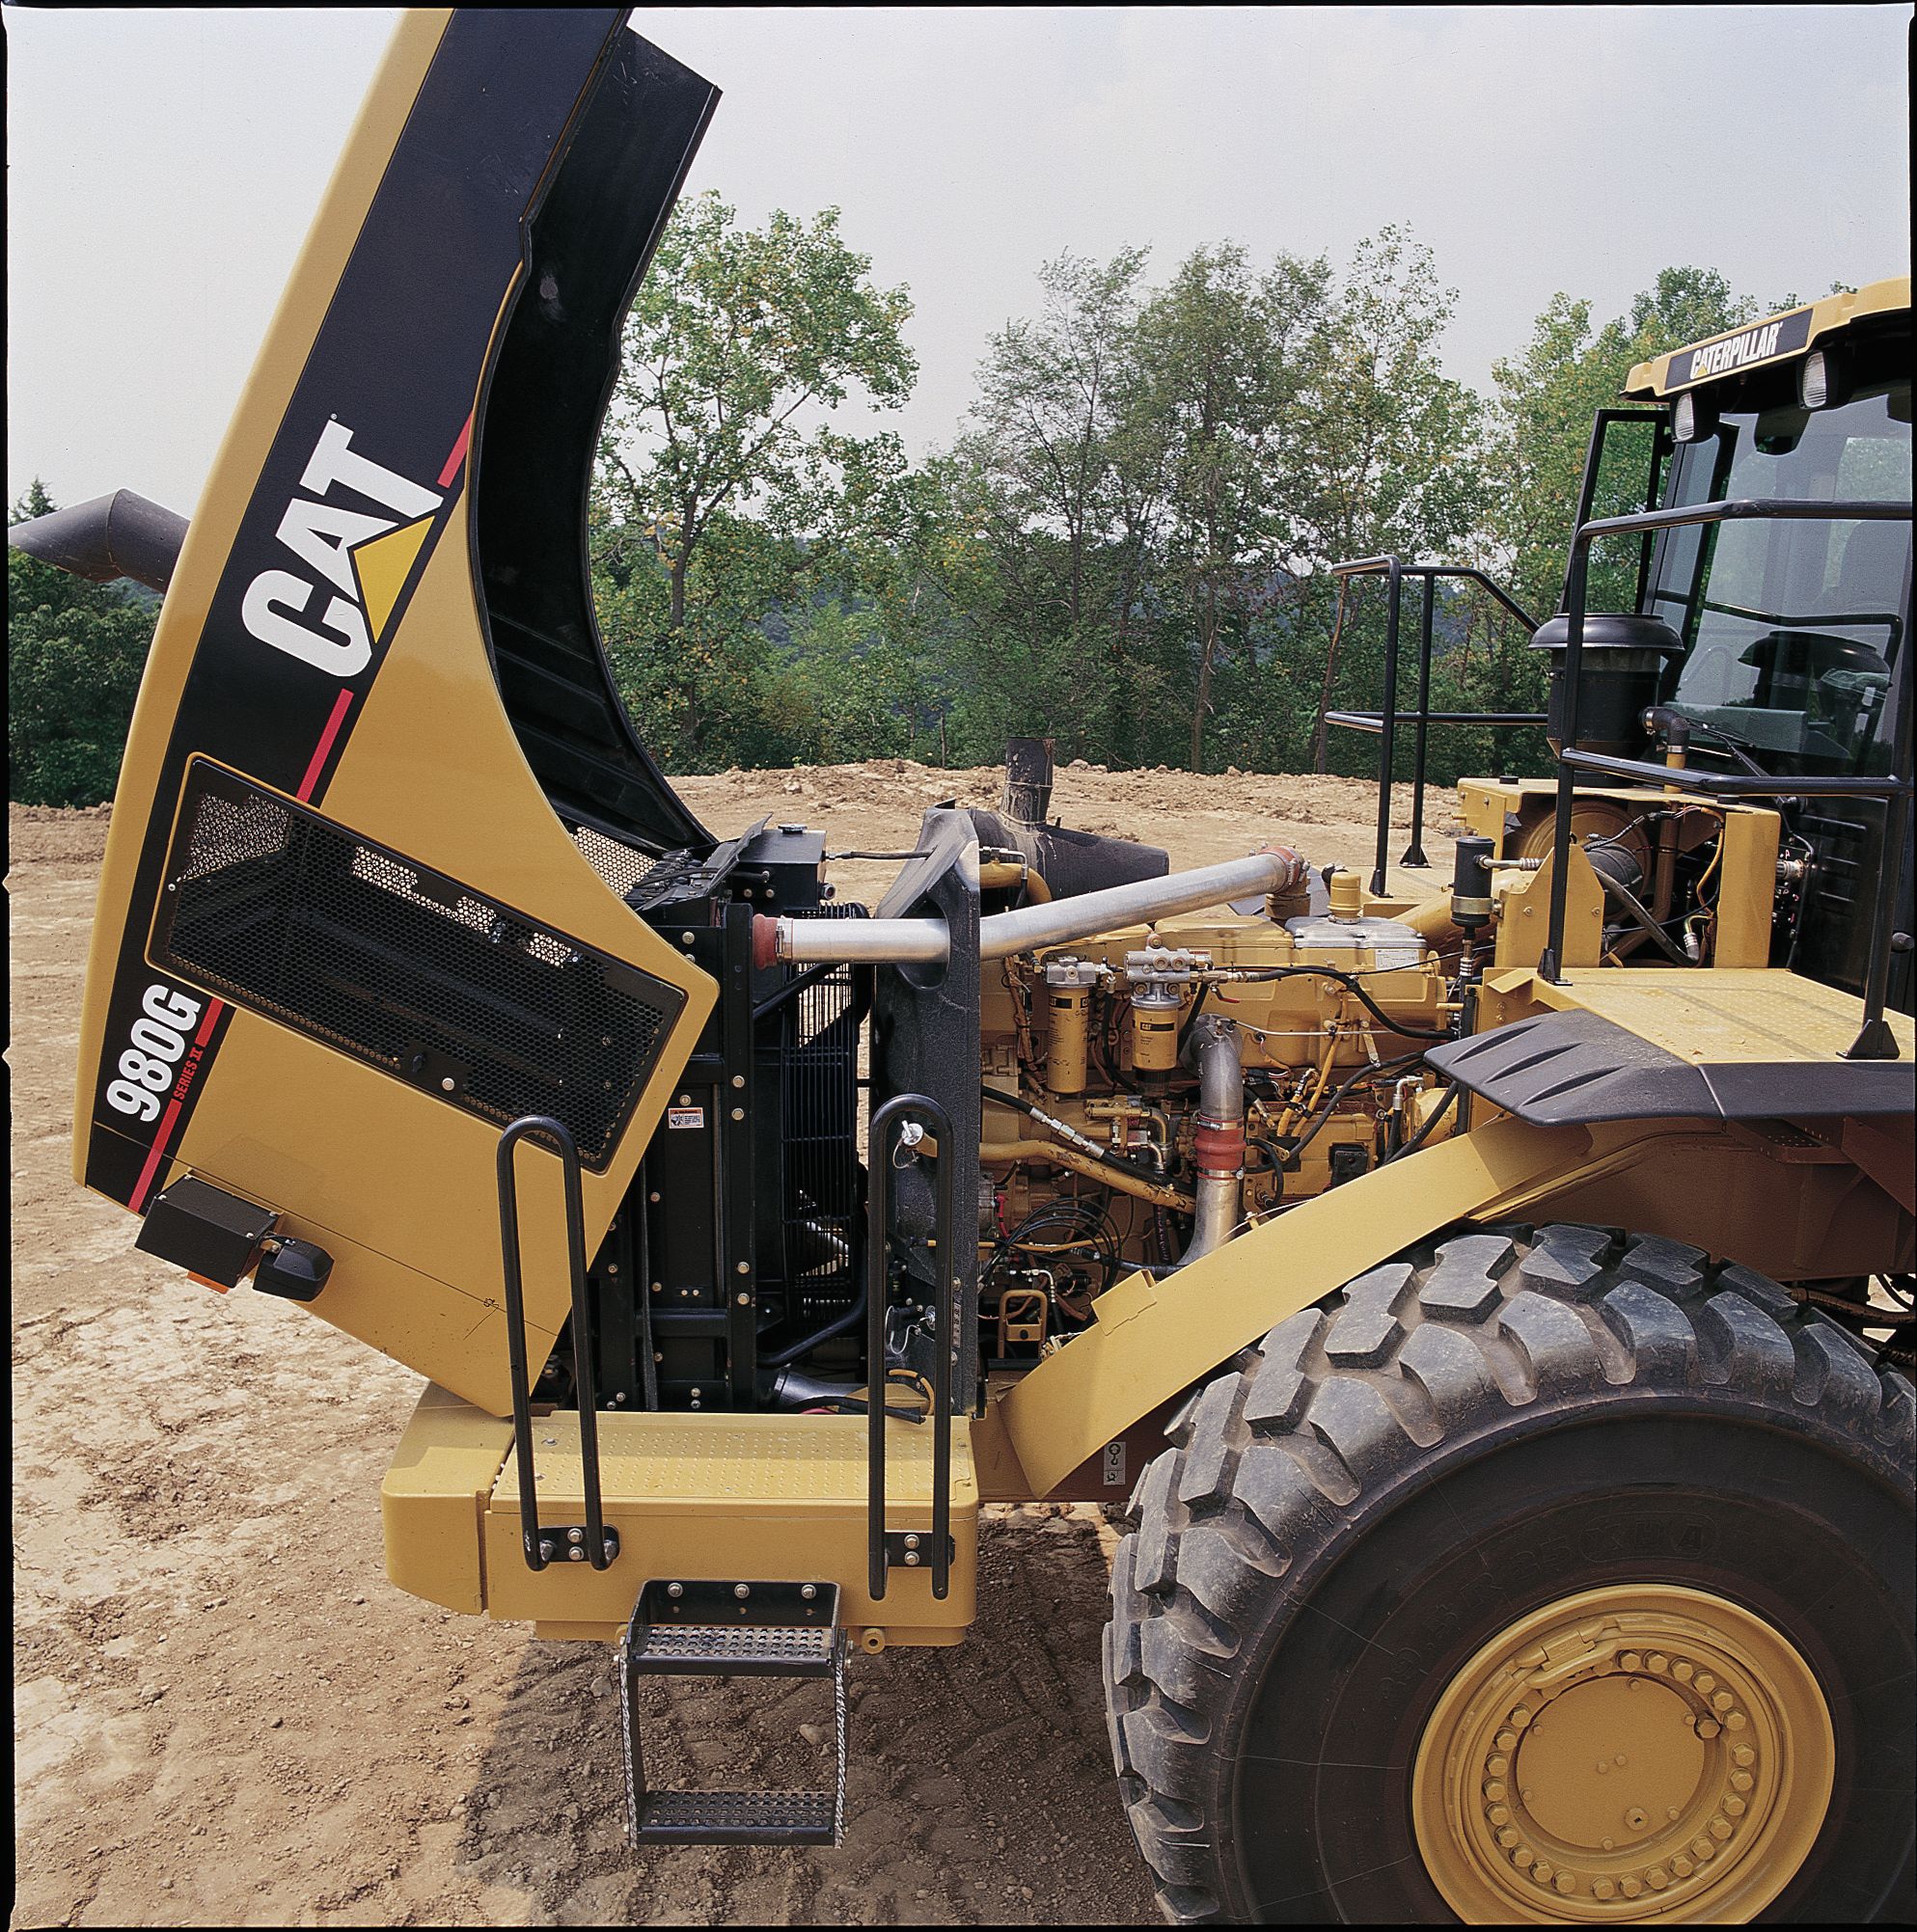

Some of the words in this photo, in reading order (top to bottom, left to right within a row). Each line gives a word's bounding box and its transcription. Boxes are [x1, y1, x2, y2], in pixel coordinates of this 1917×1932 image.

[1689, 322, 1780, 380] CATERPILLAR
[241, 419, 445, 677] CAT
[106, 984, 202, 1122] 980G
[173, 1059, 198, 1101] SERIES
